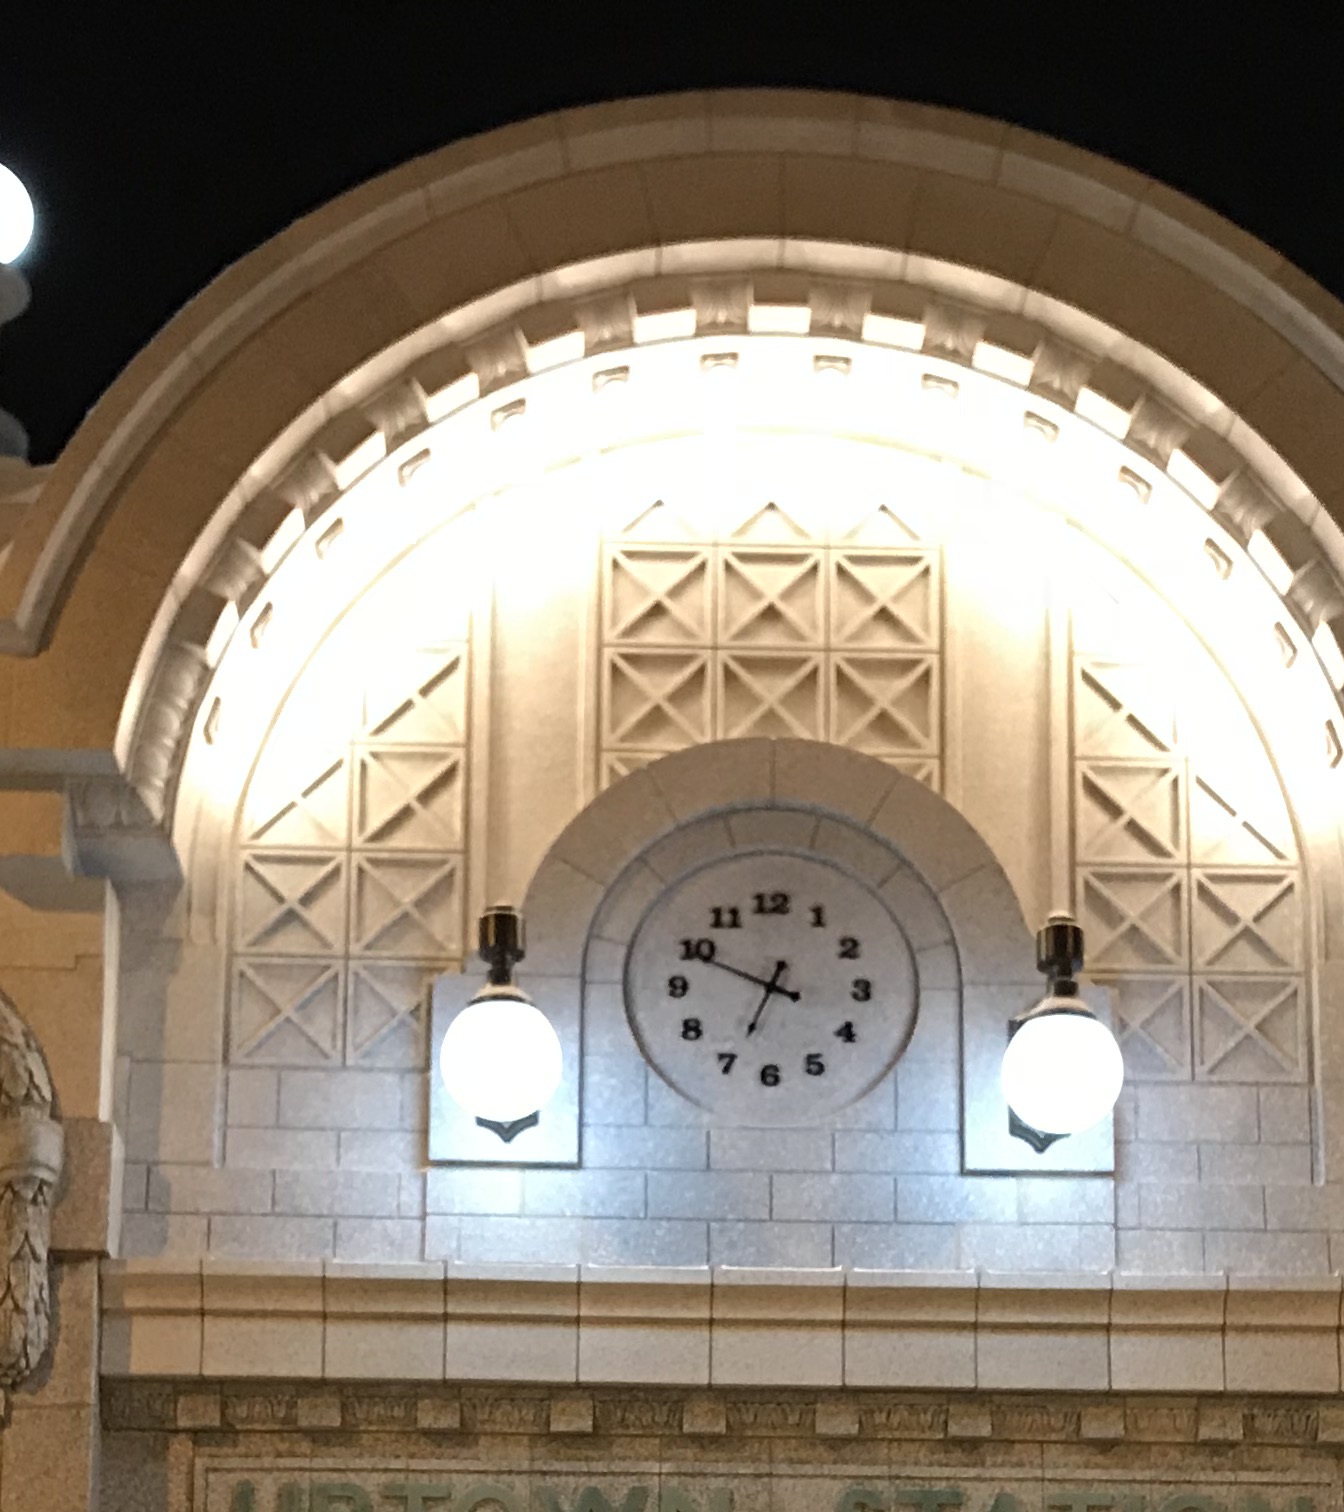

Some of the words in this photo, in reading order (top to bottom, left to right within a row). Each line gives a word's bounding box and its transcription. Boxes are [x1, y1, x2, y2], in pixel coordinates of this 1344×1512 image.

[752, 892, 791, 915] 12
[709, 907, 743, 929] 11
[810, 905, 826, 928] 1
[679, 938, 716, 961] 10
[837, 936, 860, 960] 2
[667, 975, 689, 998] 9
[851, 978, 872, 1002] 3
[681, 1018, 703, 1041] 8
[834, 1020, 856, 1043] 4
[717, 1053, 738, 1075] 7
[760, 1064, 781, 1087] 6
[805, 1053, 826, 1076] 5
